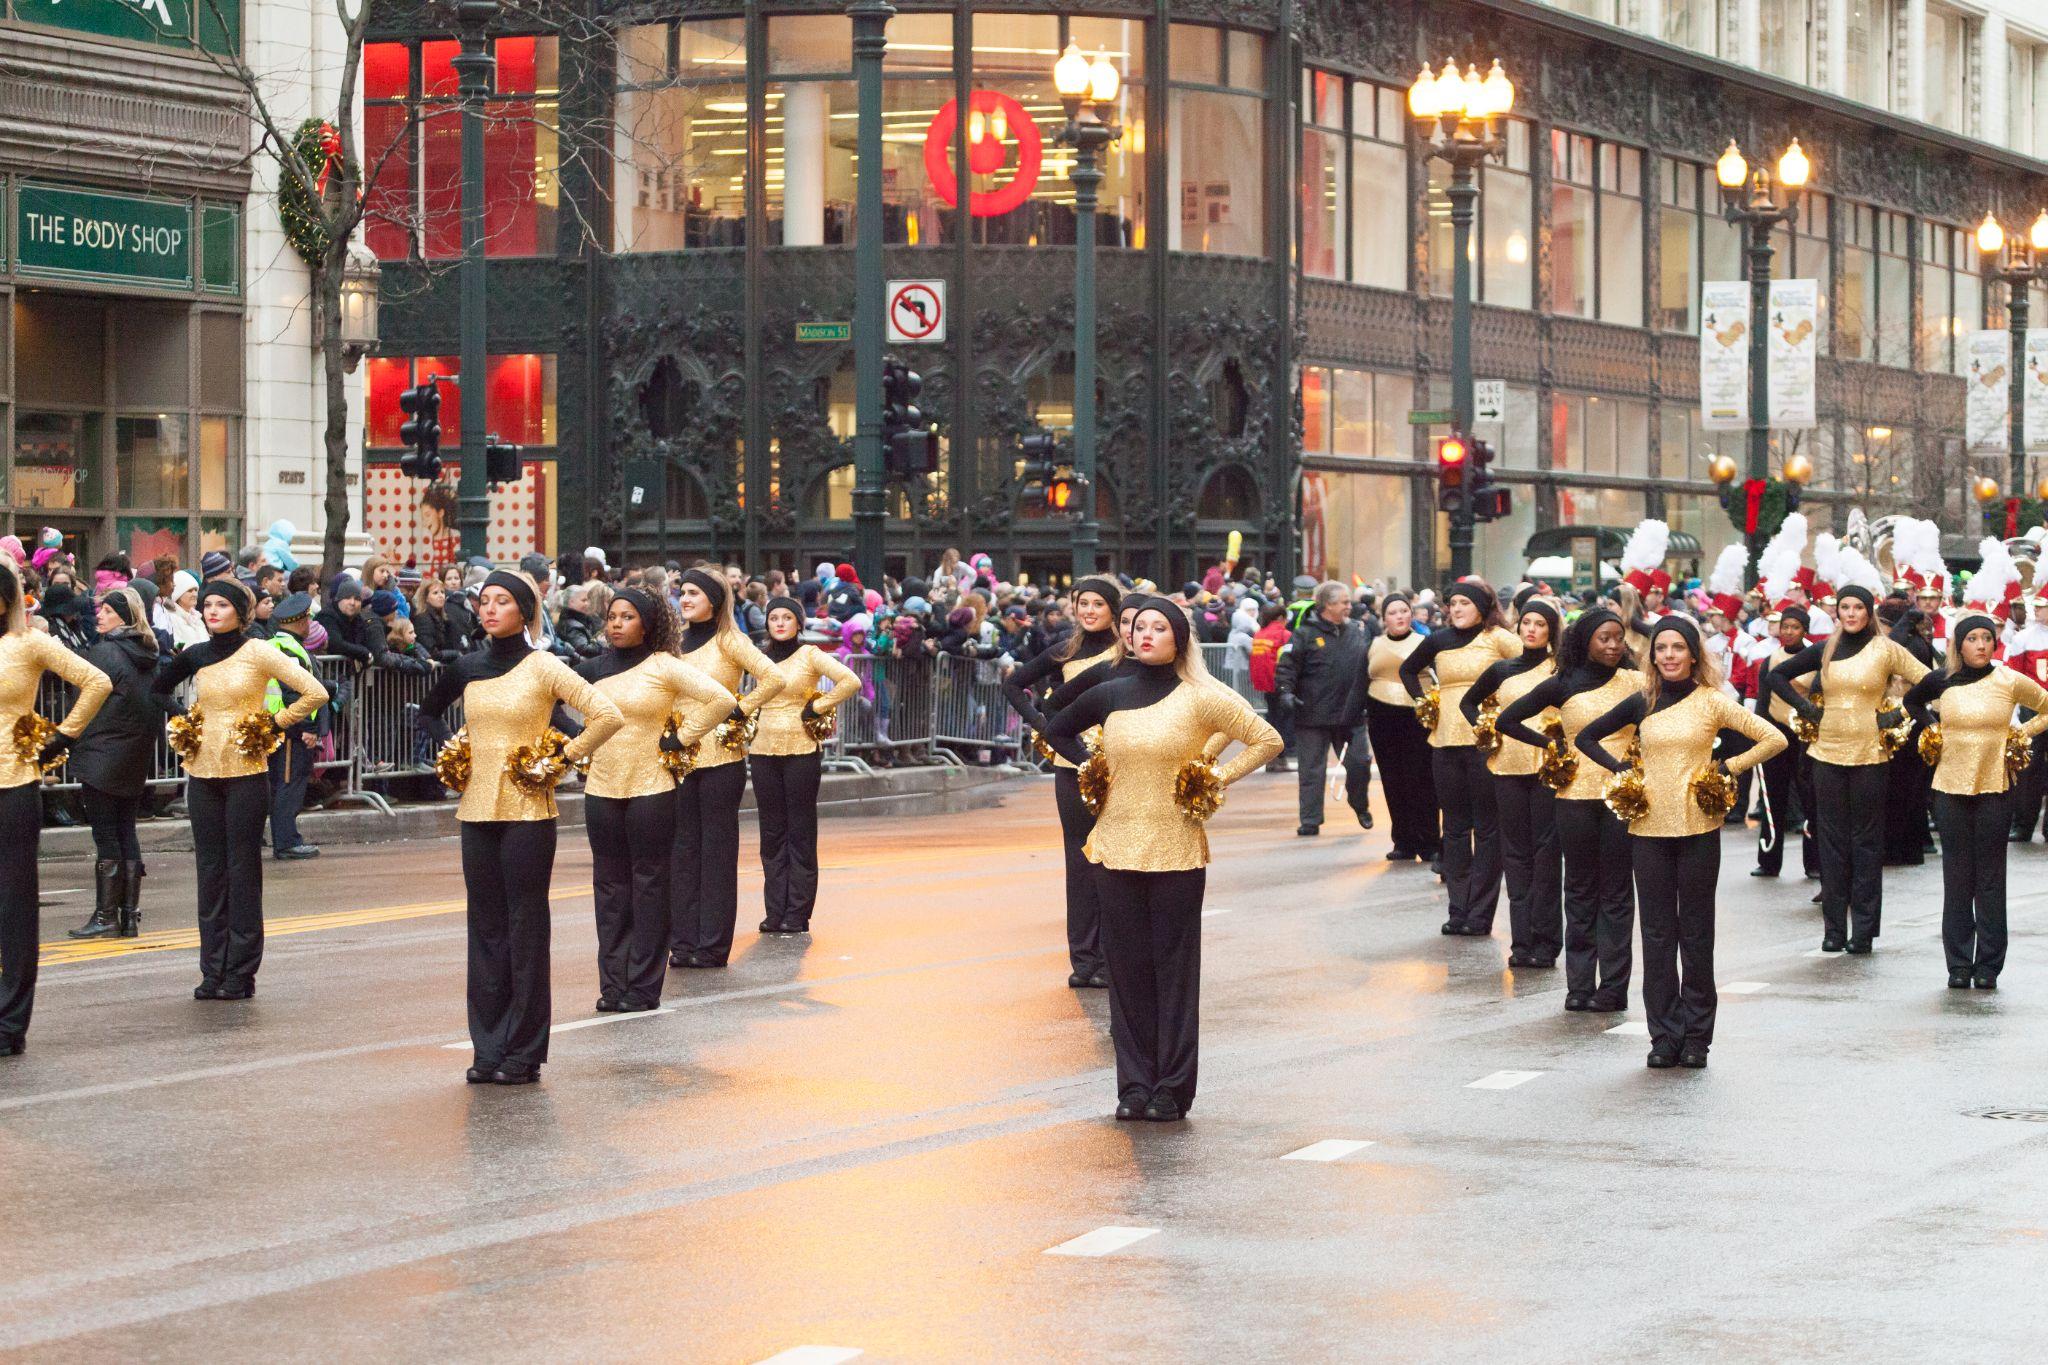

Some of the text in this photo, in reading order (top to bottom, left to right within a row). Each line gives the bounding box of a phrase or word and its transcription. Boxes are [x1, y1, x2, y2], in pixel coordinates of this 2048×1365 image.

[26, 212, 182, 256] THE BODY SHOP
[800, 326, 836, 337] MADISON
[1478, 383, 1502, 394] ONE
[1478, 396, 1502, 406] WAY
